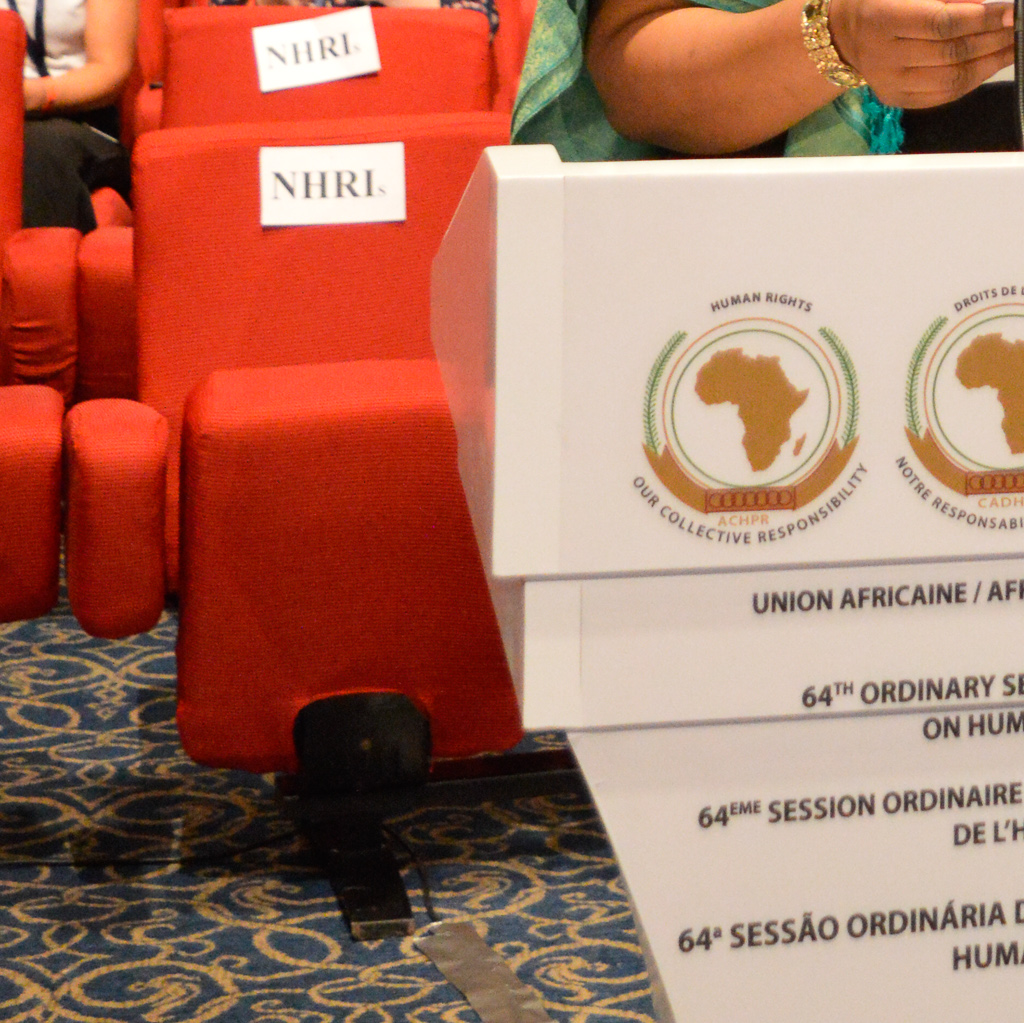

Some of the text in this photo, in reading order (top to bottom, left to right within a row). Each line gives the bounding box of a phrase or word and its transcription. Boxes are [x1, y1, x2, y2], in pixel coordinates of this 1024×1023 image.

[272, 168, 387, 200] NHRIs
[711, 292, 813, 313] HUMAN RIGHTS
[954, 288, 998, 312] DROITS
[1002, 286, 1017, 296] DE
[895, 456, 931, 501] NOTRE
[633, 462, 868, 544] OUR COLLECTIVE RESPONSIBILITY
[718, 514, 769, 526] ACHPR
[752, 590, 833, 614] UNION
[840, 582, 967, 610] AFRICAINE
[973, 581, 982, 604] /
[801, 681, 854, 708] 64TH
[860, 675, 996, 704] ORDINARY
[922, 716, 960, 740] ON
[698, 799, 762, 829] 64EME
[767, 794, 875, 823] SESSION
[882, 782, 1022, 814] ORDINAIRE
[953, 822, 986, 846] DE
[730, 912, 839, 949] SESSÃO
[847, 900, 1006, 939] ORDINÁRIA
